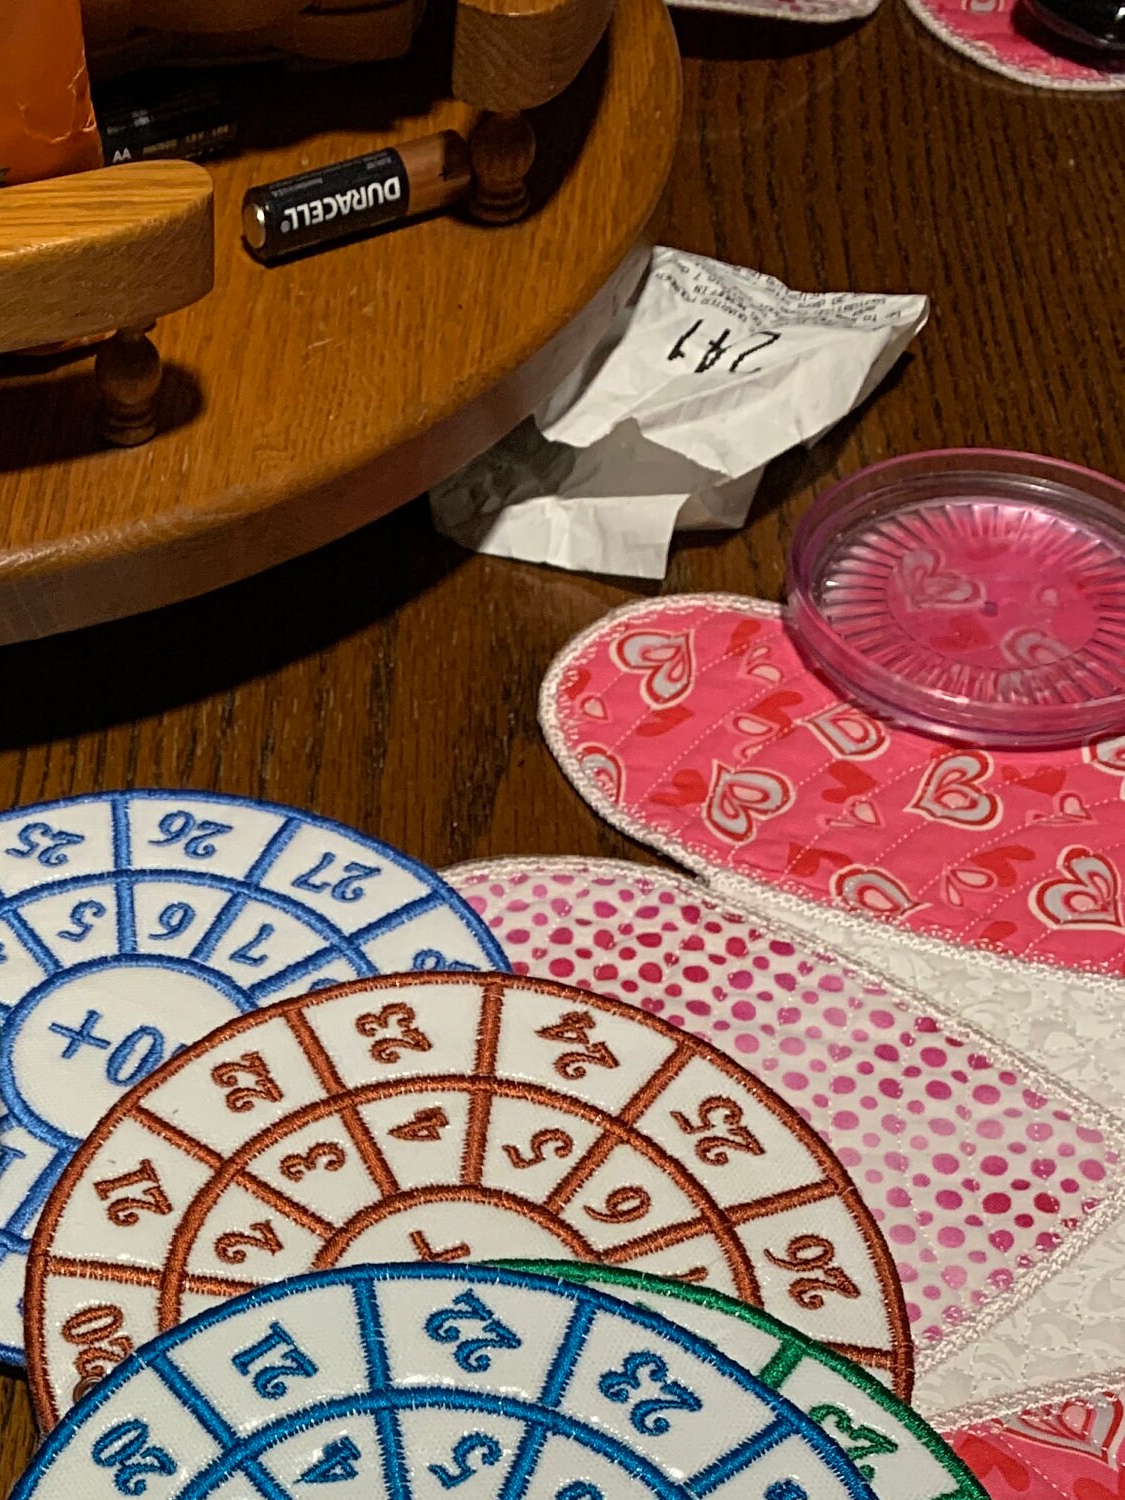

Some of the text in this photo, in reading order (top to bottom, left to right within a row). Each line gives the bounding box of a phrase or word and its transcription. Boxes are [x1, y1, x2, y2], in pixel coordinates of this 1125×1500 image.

[112, 147, 131, 163] AA
[283, 175, 402, 230] DURACELL
[6, 821, 85, 867] 25
[148, 810, 233, 858] 26
[290, 850, 383, 904] 27
[58, 900, 107, 941] 5
[230, 923, 276, 967] 7
[48, 1010, 185, 1087] 0+
[354, 1001, 433, 1063] 23
[533, 1010, 619, 1081] 24
[212, 1052, 284, 1112] 22
[387, 1106, 451, 1143] 4
[502, 1127, 574, 1170] 5
[669, 1095, 766, 1167] 25
[279, 1141, 347, 1183] 3
[93, 1158, 174, 1227] 21
[214, 1220, 285, 1265] 2
[764, 1233, 861, 1310] 26
[422, 1288, 522, 1373] 22
[231, 1322, 319, 1400] 21
[599, 1350, 702, 1436] 23
[90, 1418, 178, 1495] 20
[292, 1437, 363, 1483] 4
[430, 1431, 502, 1489] 5
